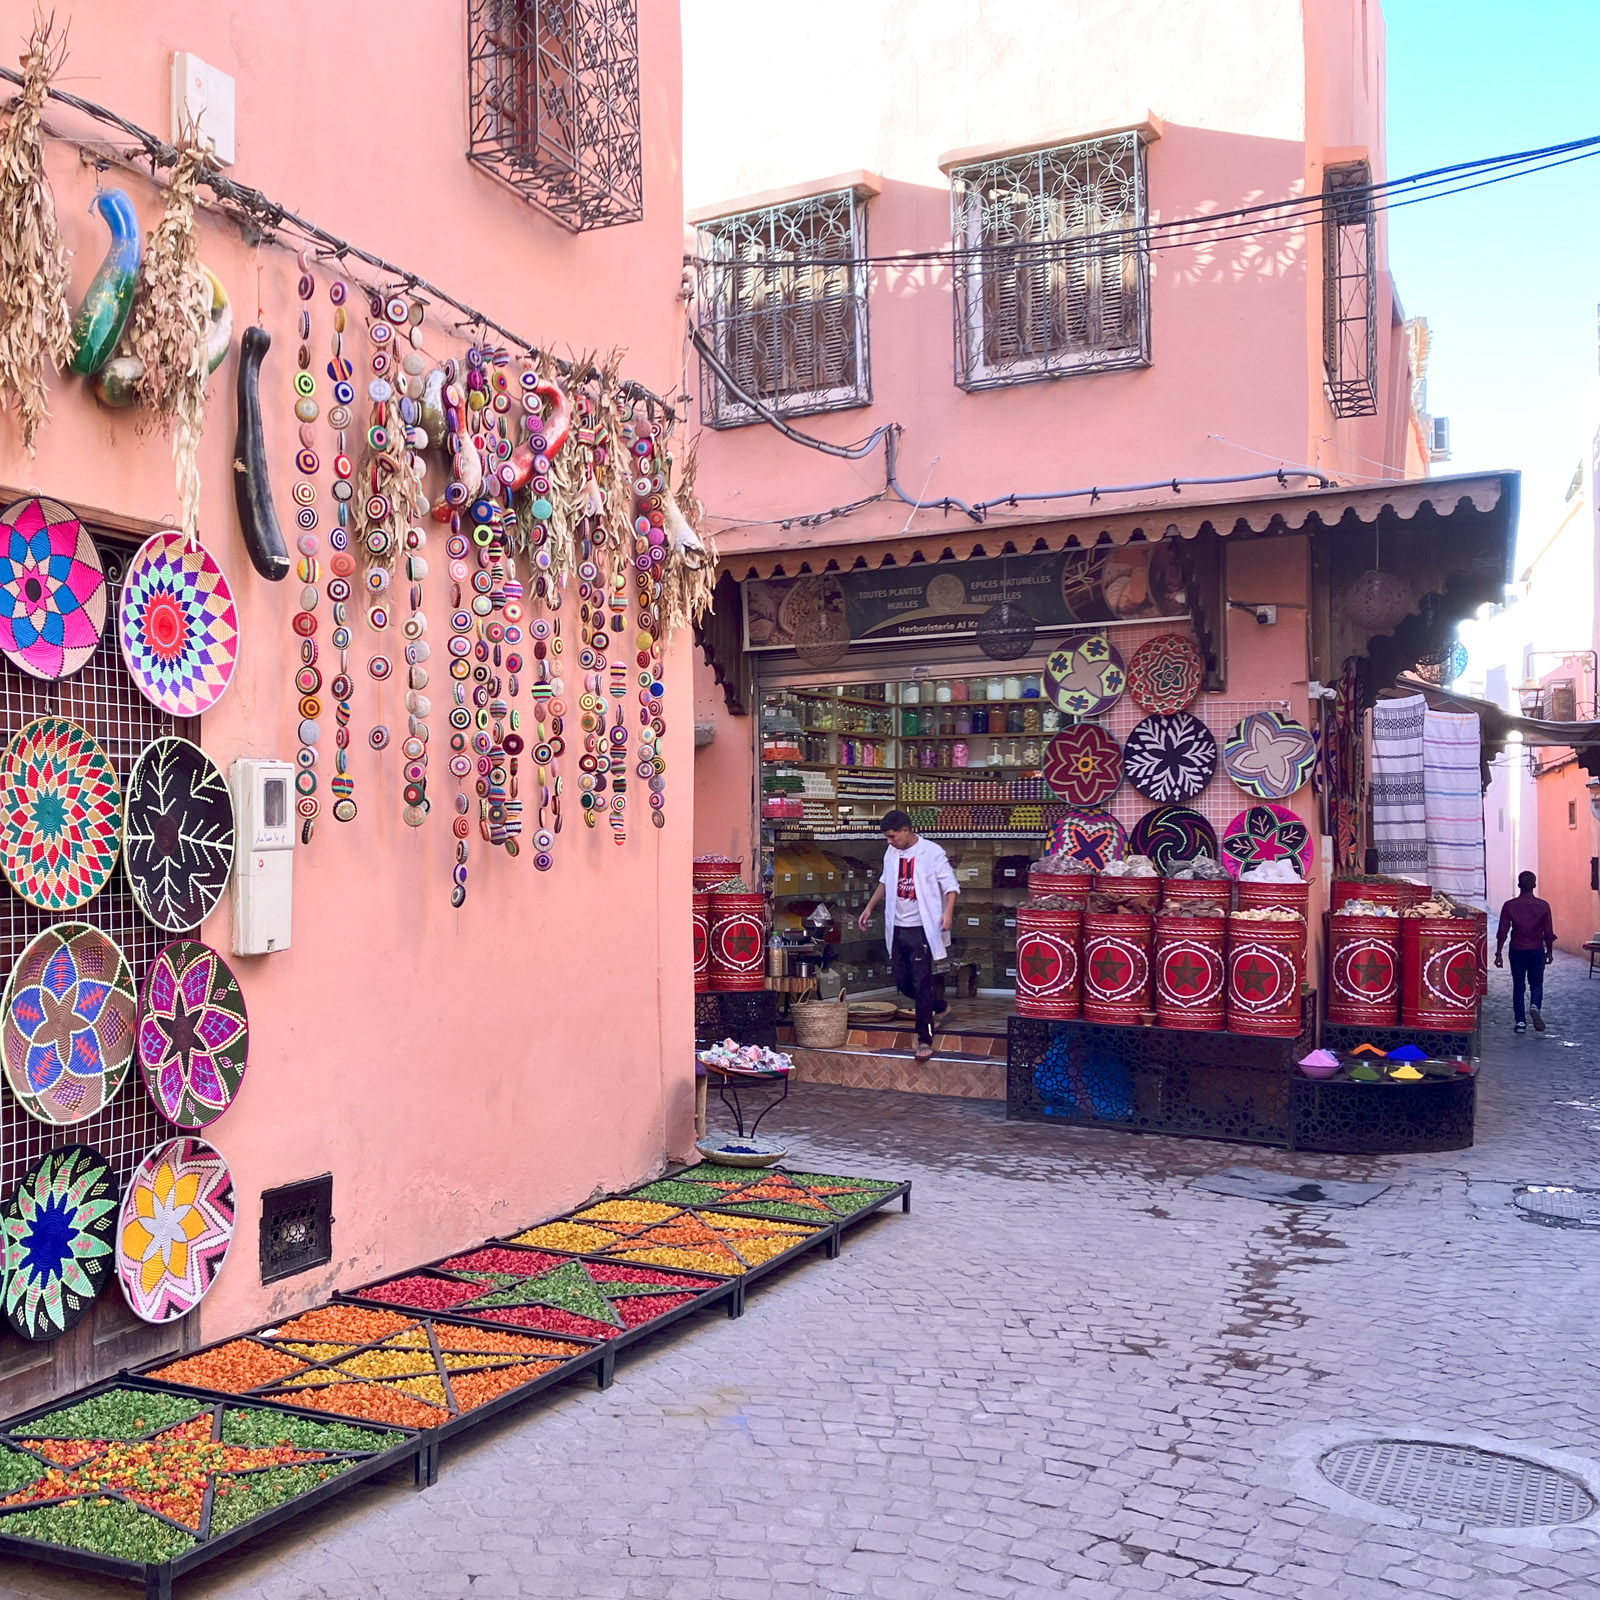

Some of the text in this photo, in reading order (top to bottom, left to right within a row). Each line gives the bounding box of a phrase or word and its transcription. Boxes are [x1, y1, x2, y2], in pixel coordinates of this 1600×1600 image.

[971, 575, 1052, 590] EPICES NATURELLES
[859, 587, 923, 599] TOUTES PLANTES
[887, 600, 919, 610] HUILLES
[898, 622, 955, 634] Herboristerie
